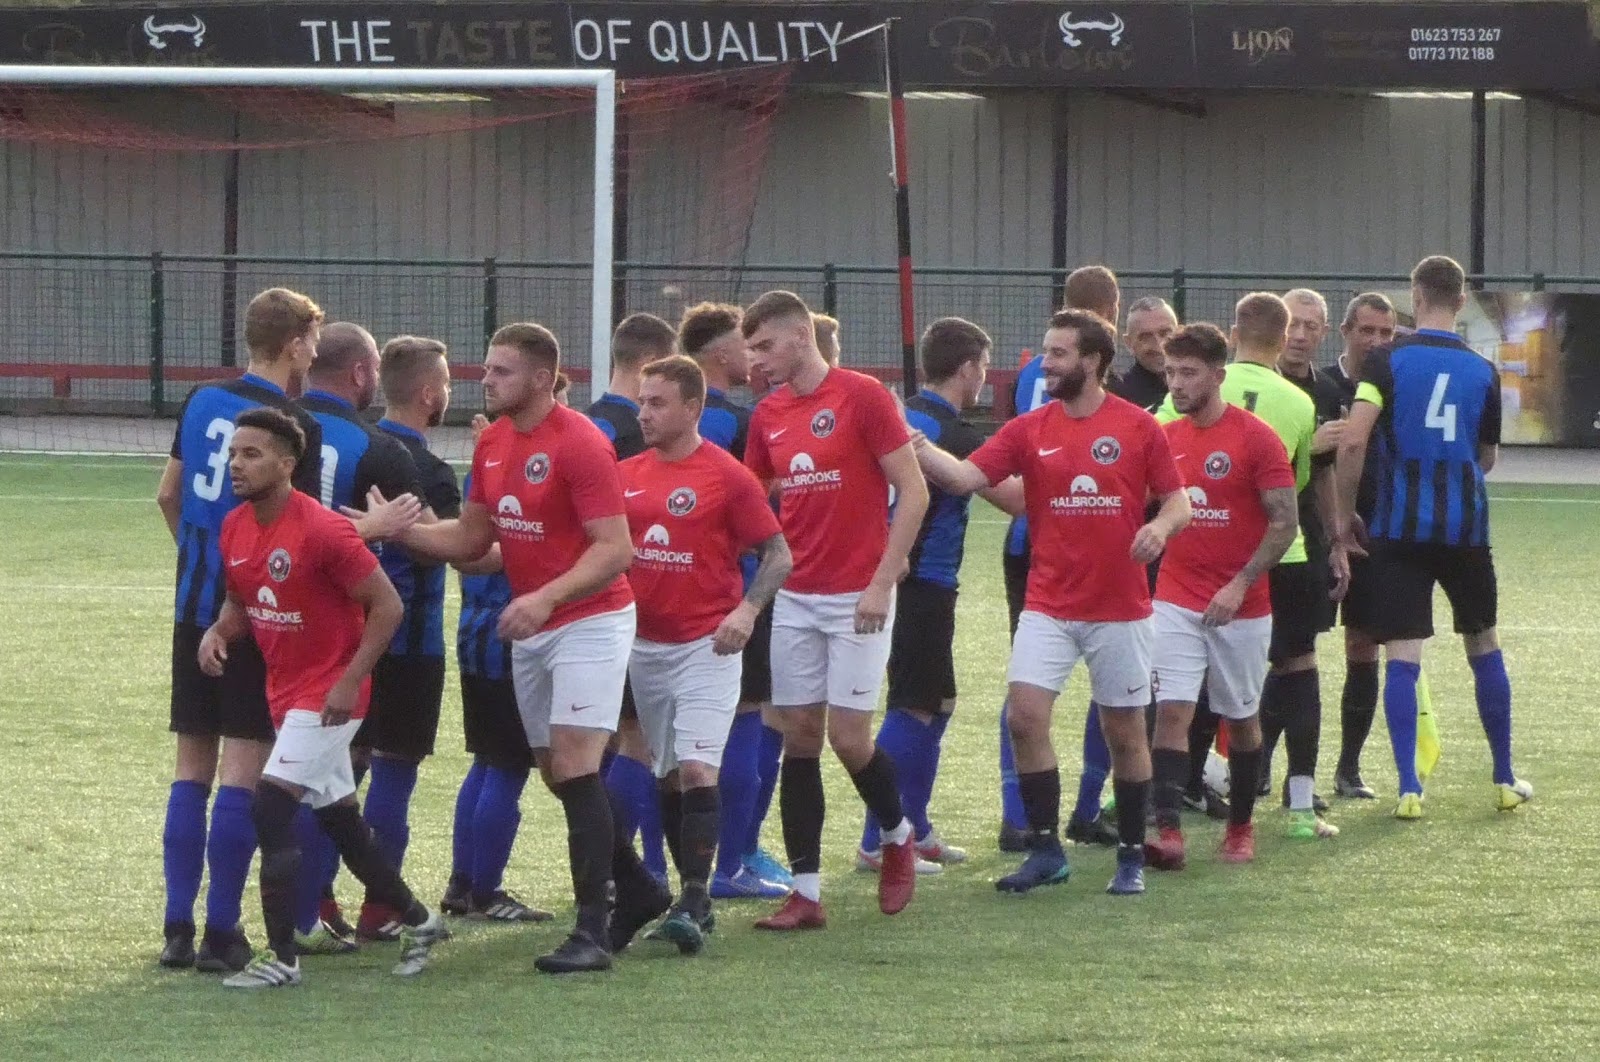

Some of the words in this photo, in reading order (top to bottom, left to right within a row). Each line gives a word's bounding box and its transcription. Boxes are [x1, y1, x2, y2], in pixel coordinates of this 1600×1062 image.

[300, 20, 395, 62] THE
[407, 20, 552, 62] TASTE
[574, 19, 632, 61] OF
[649, 20, 843, 63] QUALITY
[1232, 27, 1294, 61] LION
[1408, 47, 1446, 60] 01773
[1448, 47, 1470, 60] 712
[1471, 47, 1494, 60] 188
[1411, 28, 1449, 41] 01623
[1450, 28, 1475, 41] 753
[1478, 28, 1501, 41] 267
[1425, 373, 1456, 442] 4
[193, 418, 236, 502] 3
